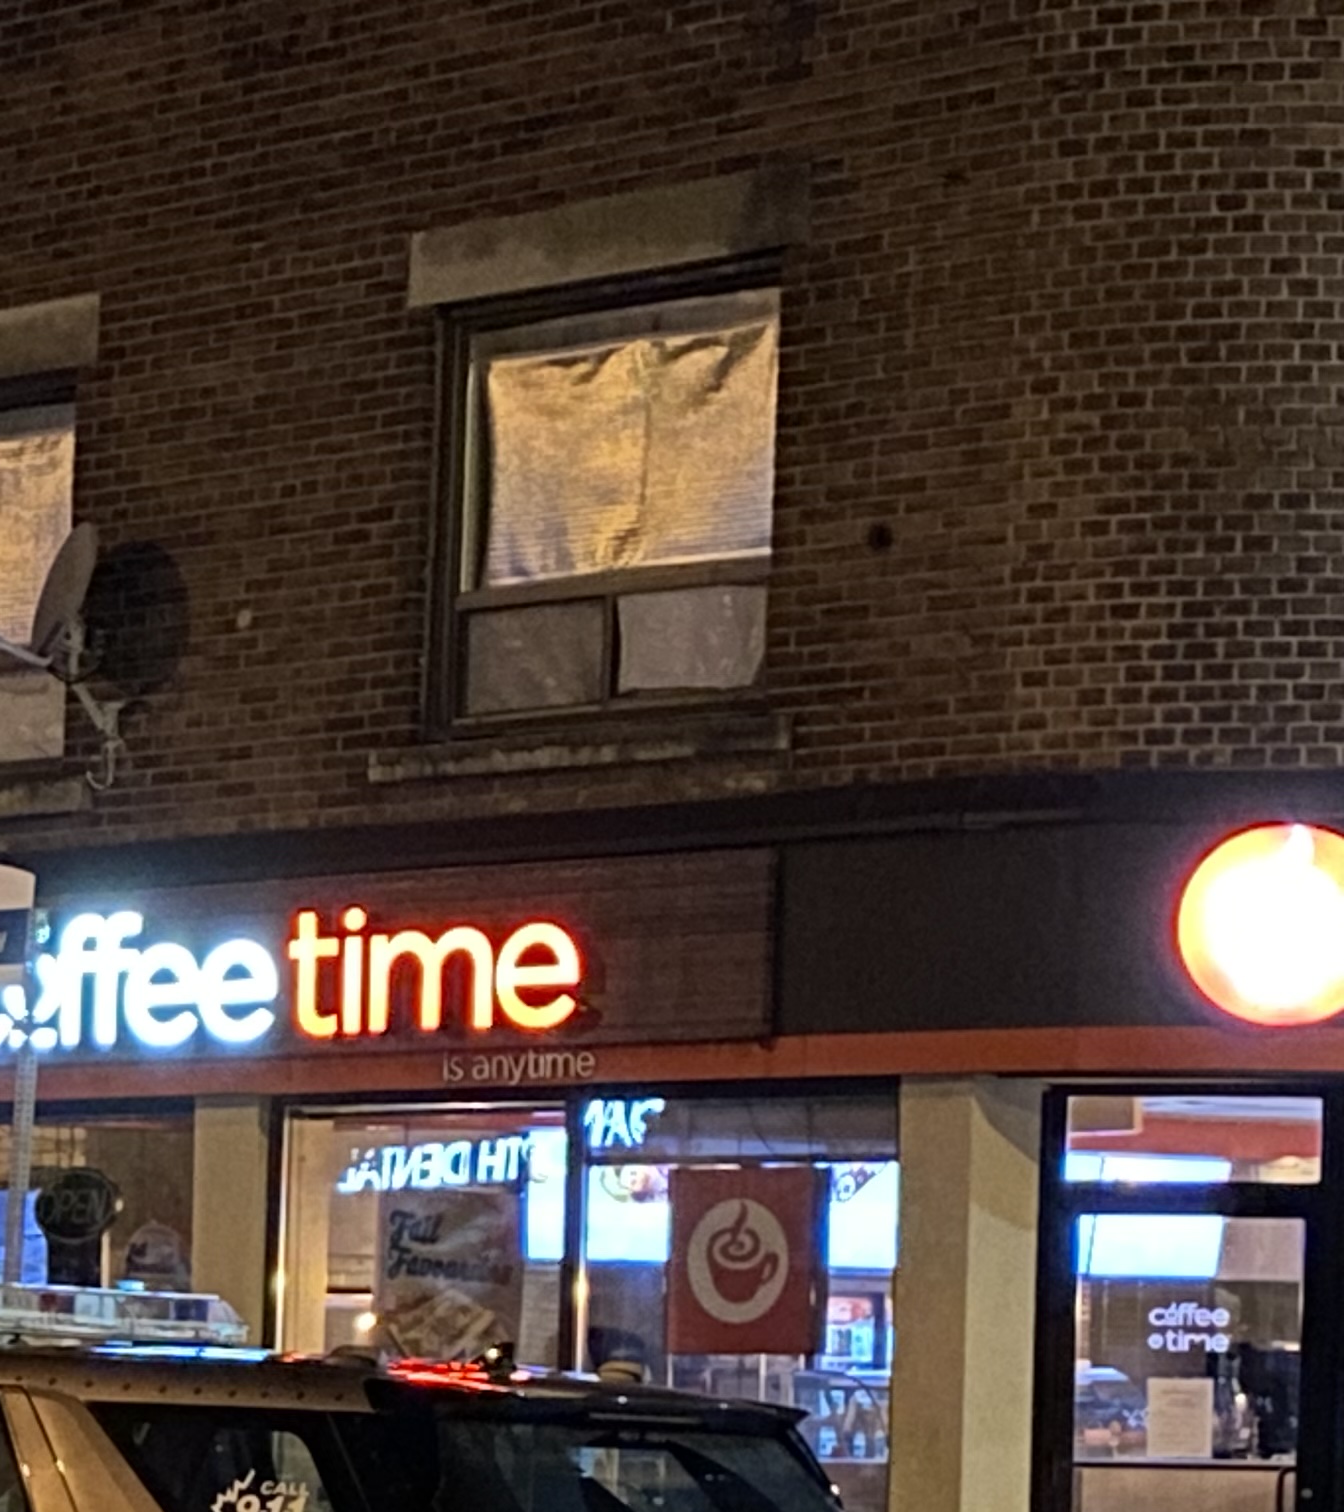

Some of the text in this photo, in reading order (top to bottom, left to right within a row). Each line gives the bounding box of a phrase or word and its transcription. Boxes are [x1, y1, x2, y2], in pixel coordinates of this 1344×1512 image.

[288, 906, 580, 1037] time
[443, 1049, 597, 1085] is anytime
[1148, 1301, 1231, 1328] coffee
[1165, 1329, 1231, 1353] time
[260, 1480, 310, 1498] CALL
